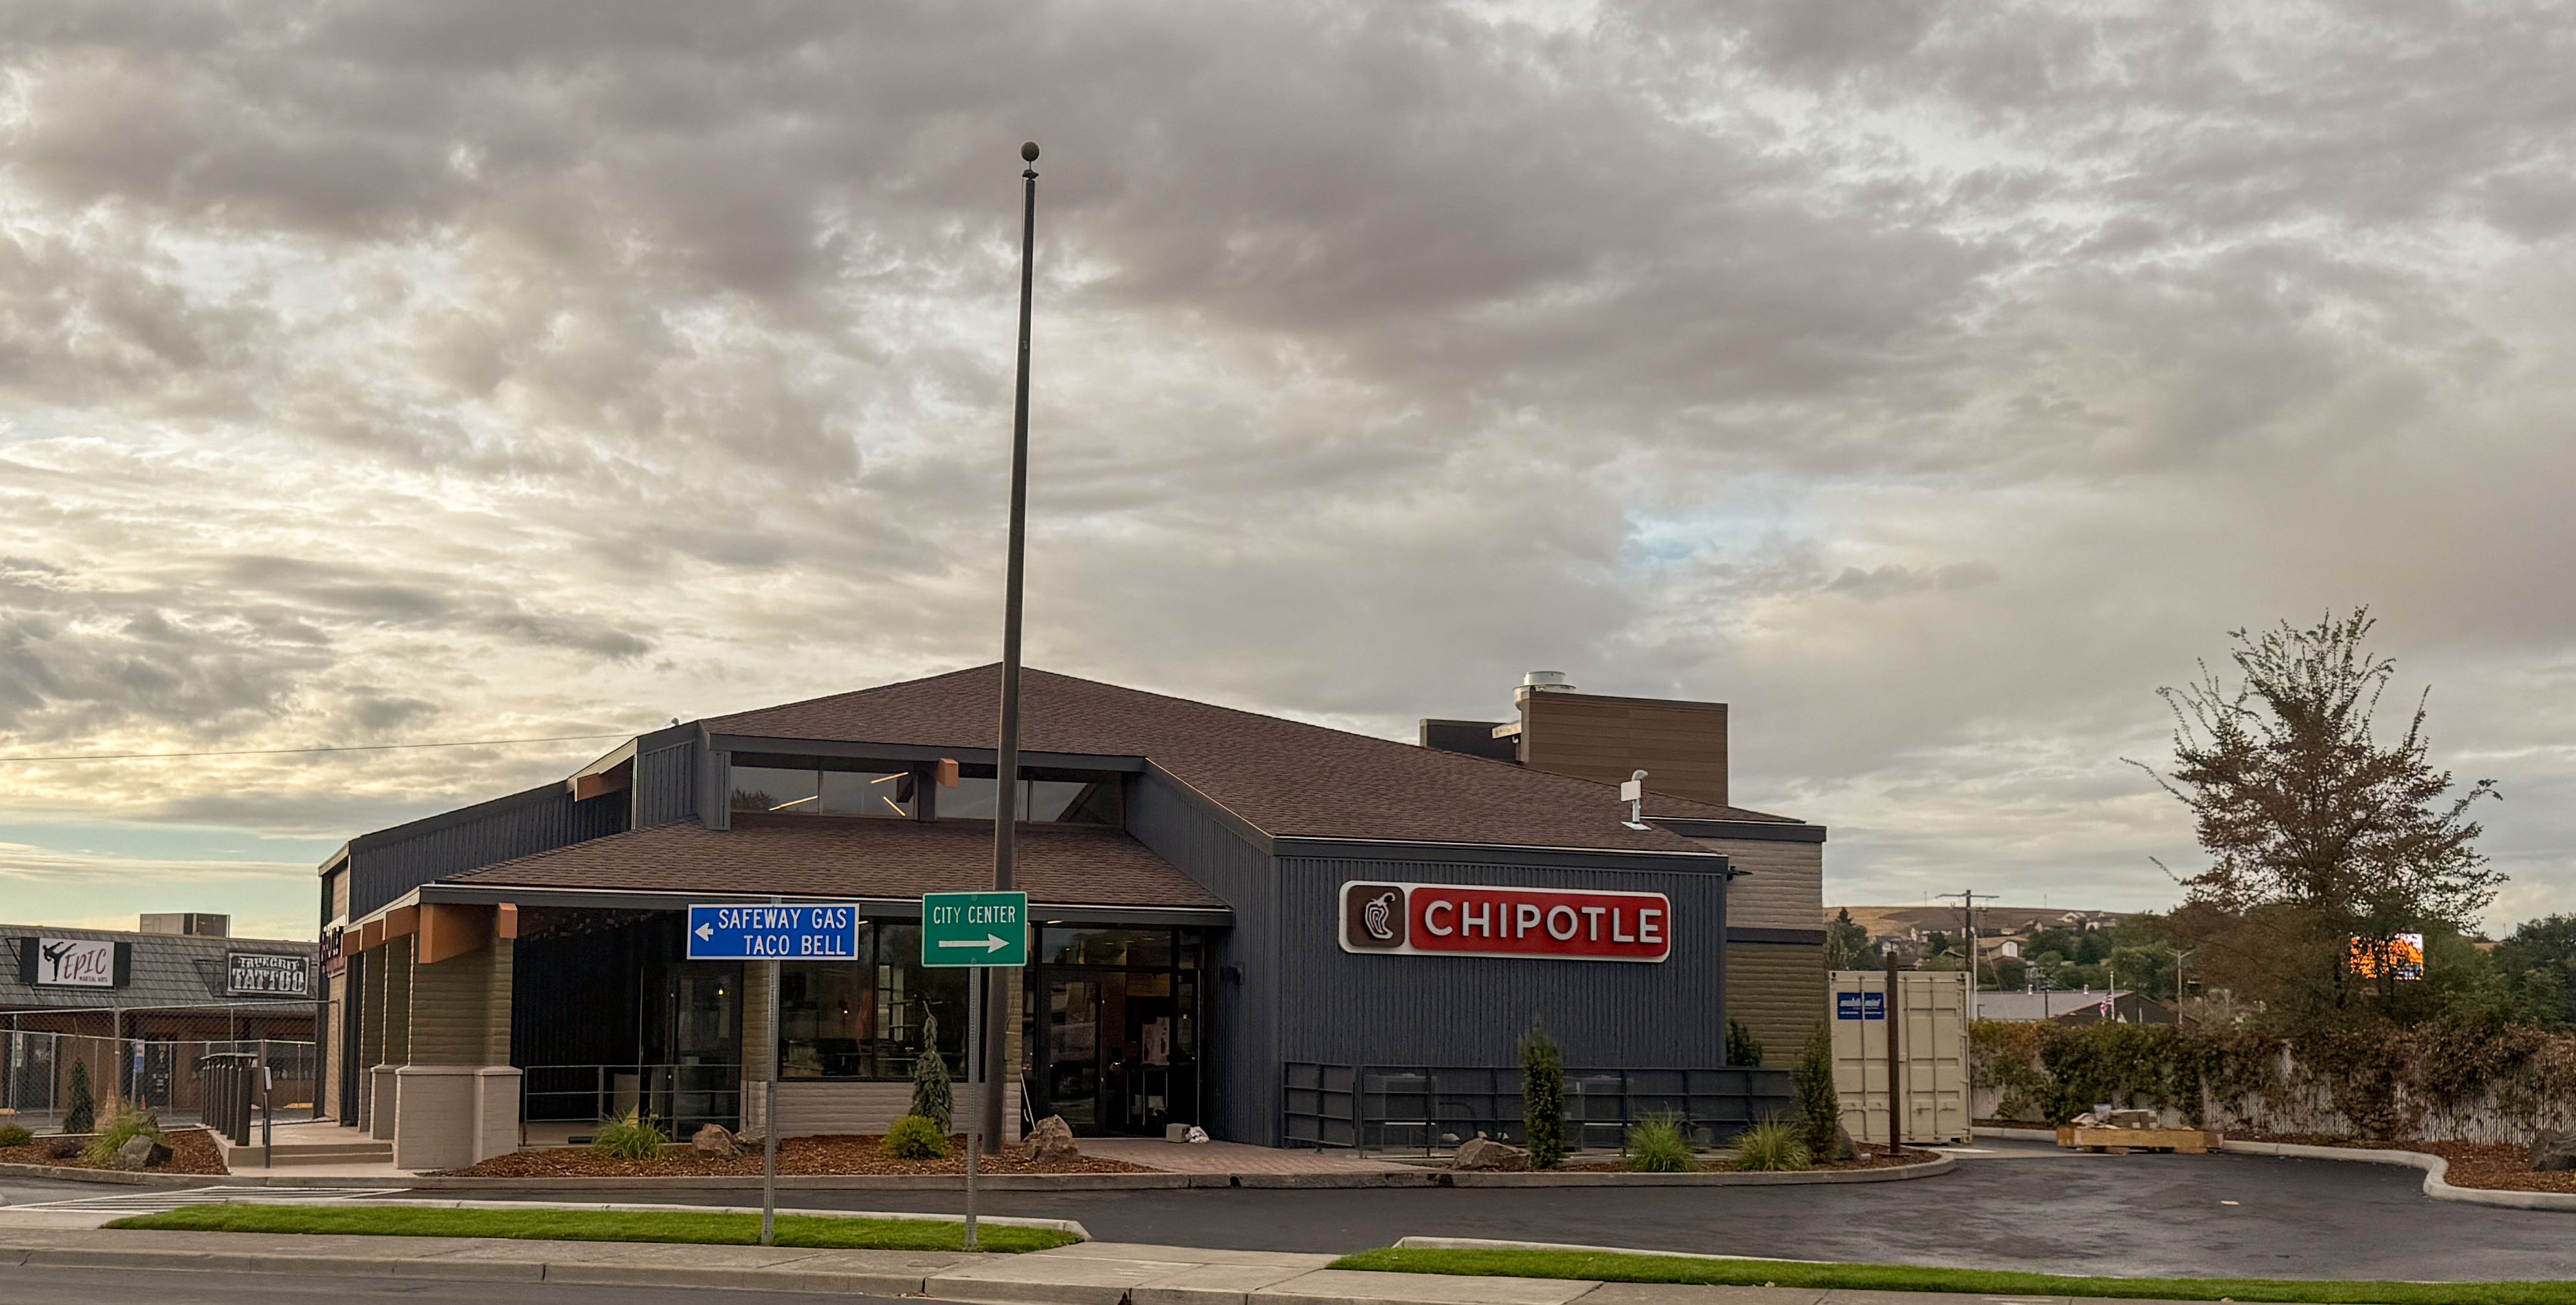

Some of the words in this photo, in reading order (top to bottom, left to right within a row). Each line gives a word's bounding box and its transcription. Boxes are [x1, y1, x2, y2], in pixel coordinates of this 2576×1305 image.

[718, 908, 801, 929] SAFEWAY
[812, 908, 848, 929] GAS
[933, 906, 961, 924] CITY
[968, 906, 1016, 923] CENTER
[1424, 900, 1663, 944] CHIPOTLE
[743, 935, 790, 956] TACO
[801, 935, 847, 956] BELL
[64, 948, 107, 980] EPIC
[232, 968, 304, 992] TATTOO
